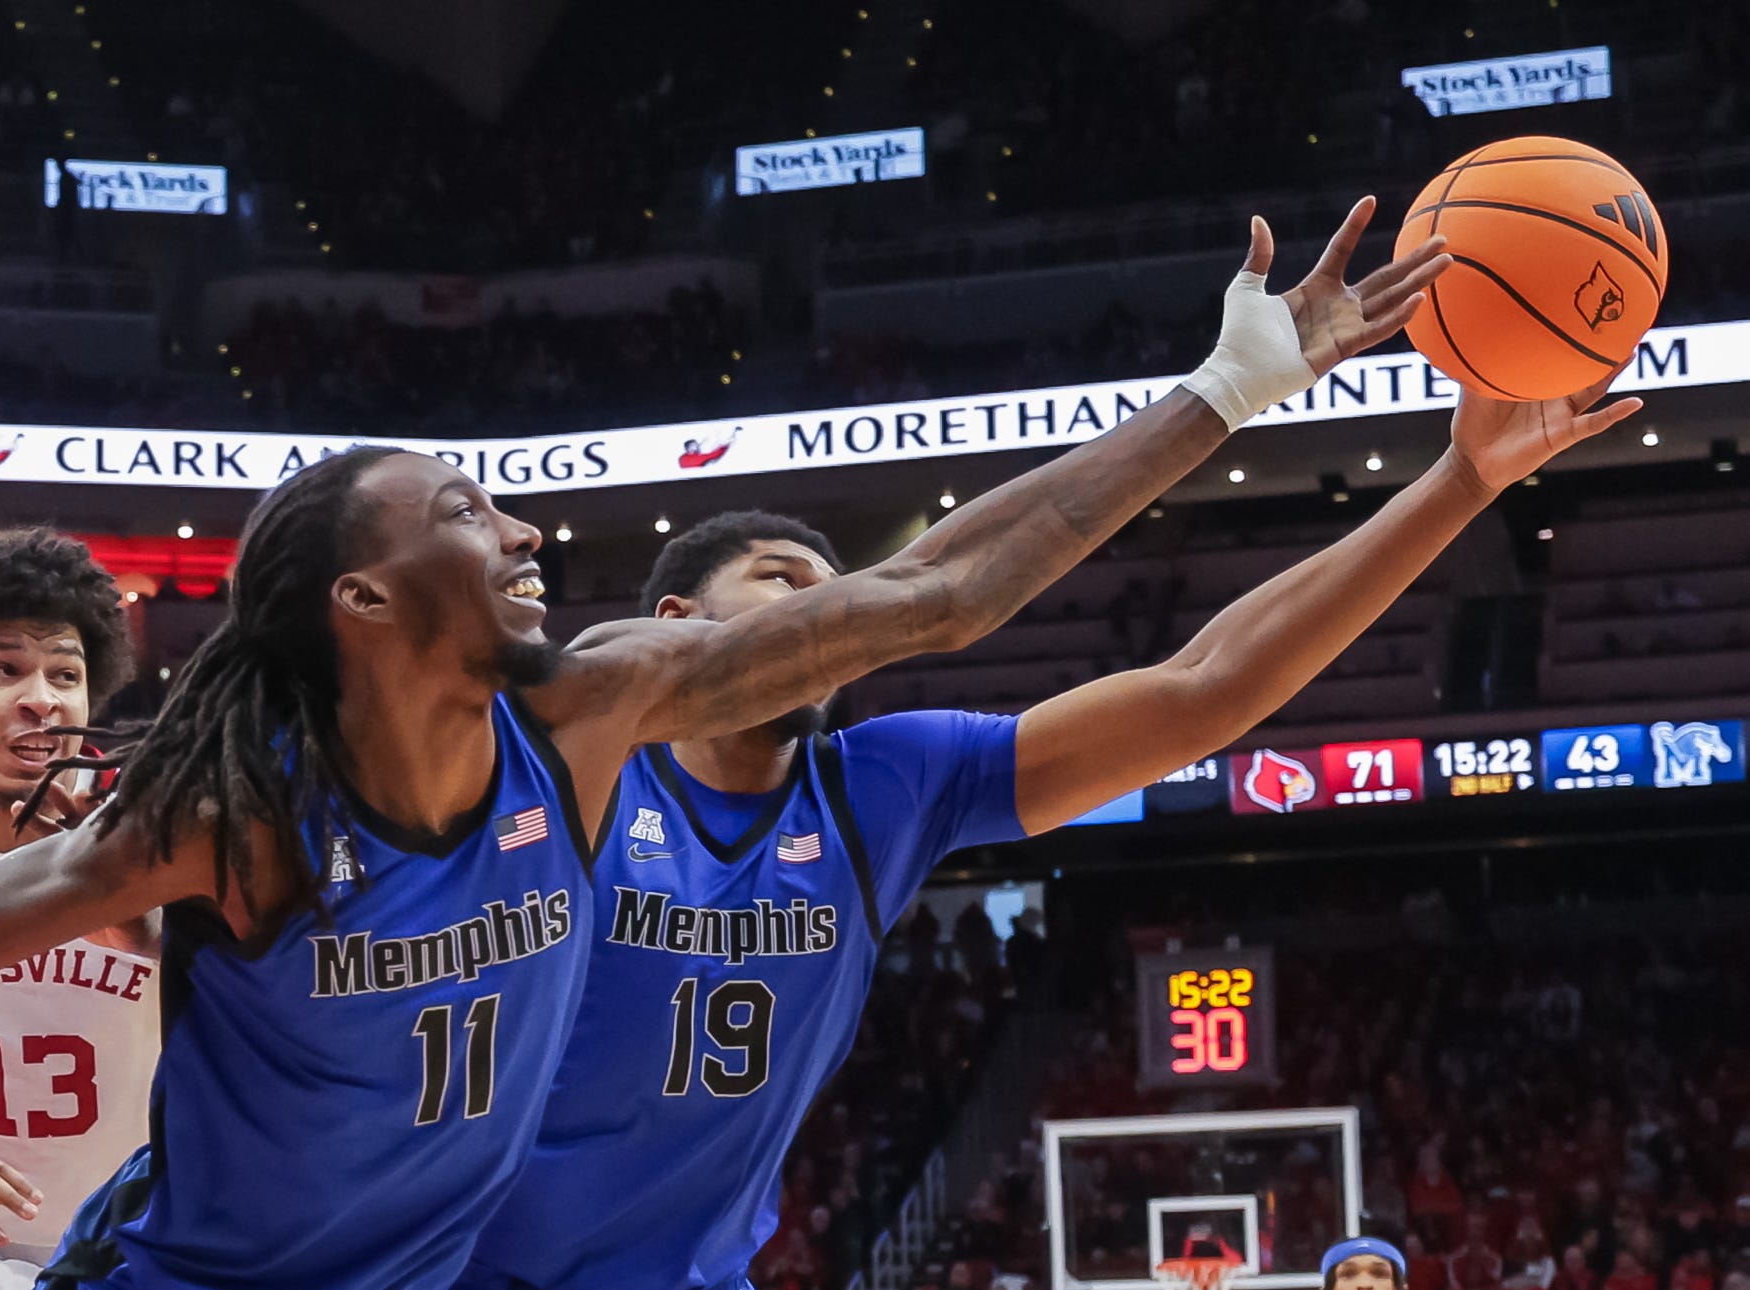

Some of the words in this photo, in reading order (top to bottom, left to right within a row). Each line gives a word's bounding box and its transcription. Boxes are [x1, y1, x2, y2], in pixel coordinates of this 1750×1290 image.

[1423, 70, 1501, 92] Stock
[1507, 58, 1591, 84] Yards
[753, 148, 827, 172] Stock
[832, 138, 906, 164] Yards
[138, 172, 209, 192] Yards
[55, 436, 249, 479] CLARK
[1346, 749, 1395, 789] 71
[1434, 738, 1533, 777] 15:22
[1566, 735, 1620, 774] 43
[307, 888, 571, 998] Memphis
[1168, 967, 1255, 1010] 15:22
[661, 977, 777, 1098] 19
[1170, 1006, 1249, 1074] 30
[411, 992, 502, 1127] 11
